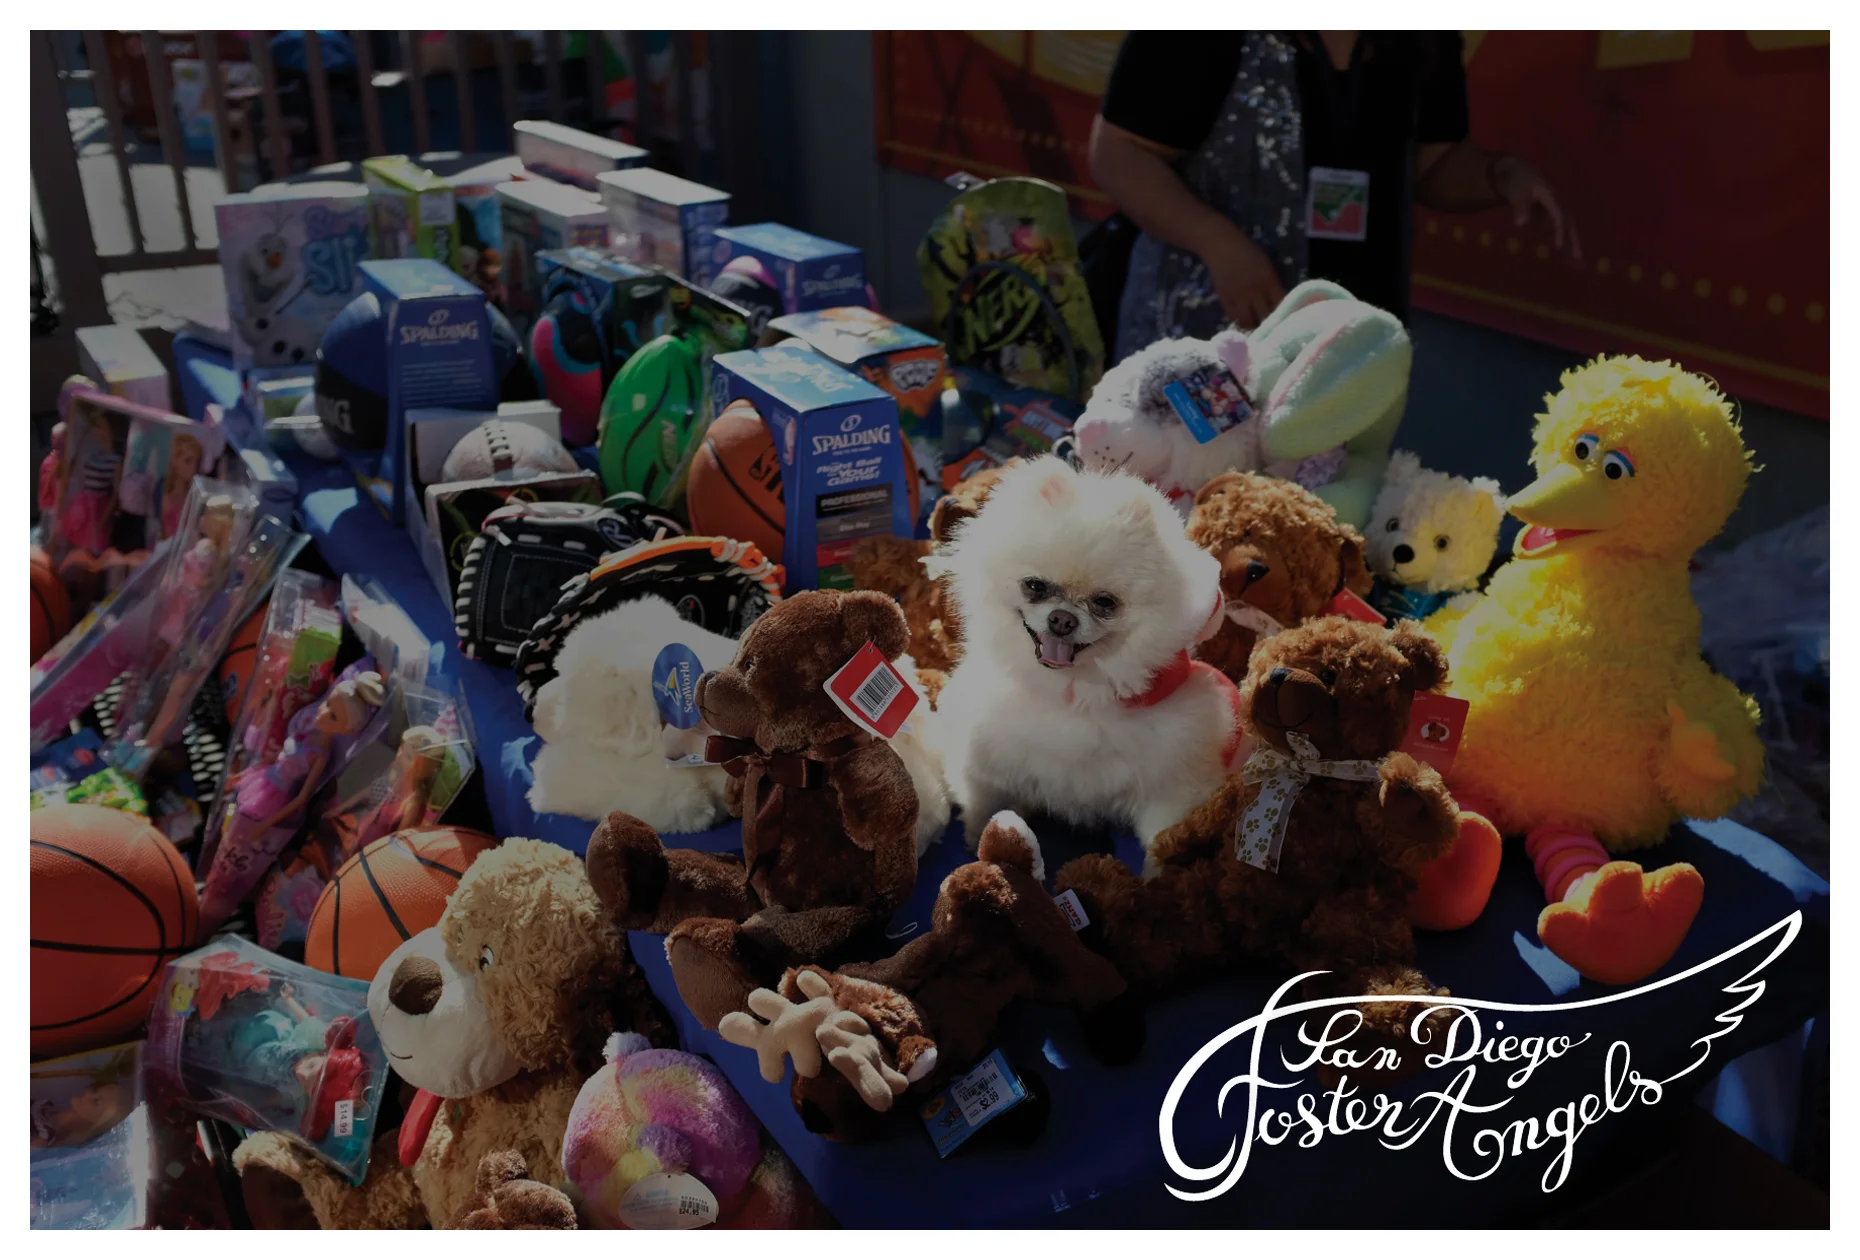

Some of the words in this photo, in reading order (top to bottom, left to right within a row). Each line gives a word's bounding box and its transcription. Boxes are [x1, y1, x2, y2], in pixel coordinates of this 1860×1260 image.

[400, 320, 479, 344] SPALDING
[812, 424, 892, 456] SPALDING
[679, 661, 694, 713] SeaWorld
